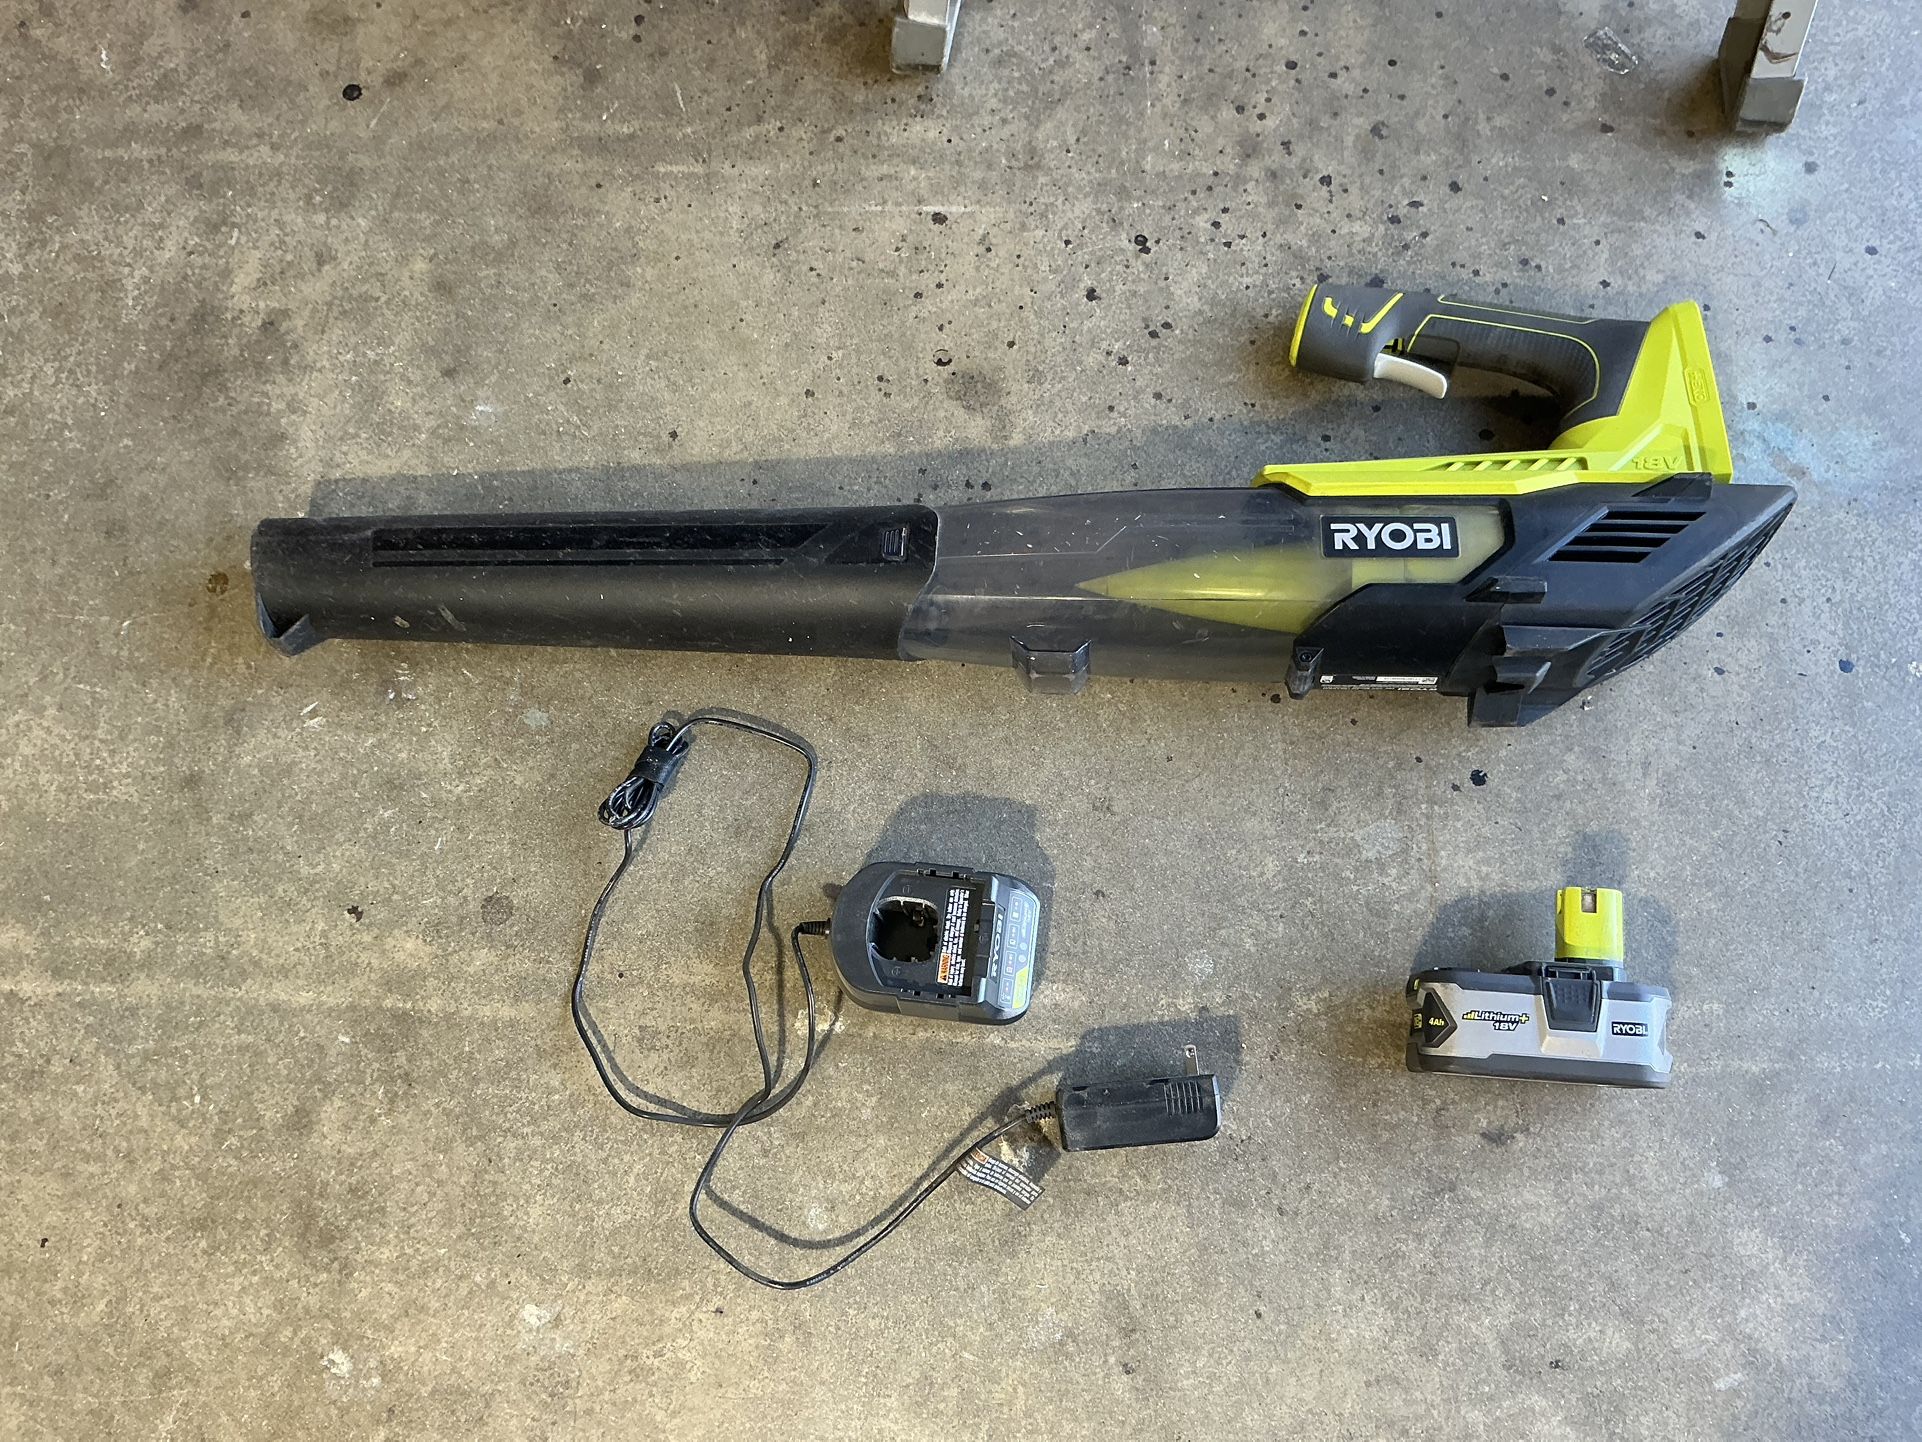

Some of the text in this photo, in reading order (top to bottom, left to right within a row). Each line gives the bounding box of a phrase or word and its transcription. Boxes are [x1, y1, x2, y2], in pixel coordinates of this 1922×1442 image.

[1632, 456, 1682, 471] 18V
[1330, 522, 1452, 550] RYOBI
[991, 913, 1003, 977] RYOBI
[1428, 1017, 1445, 1026] 4Ah
[1474, 1011, 1529, 1023] Lithium+
[1493, 1022, 1517, 1031] 18V
